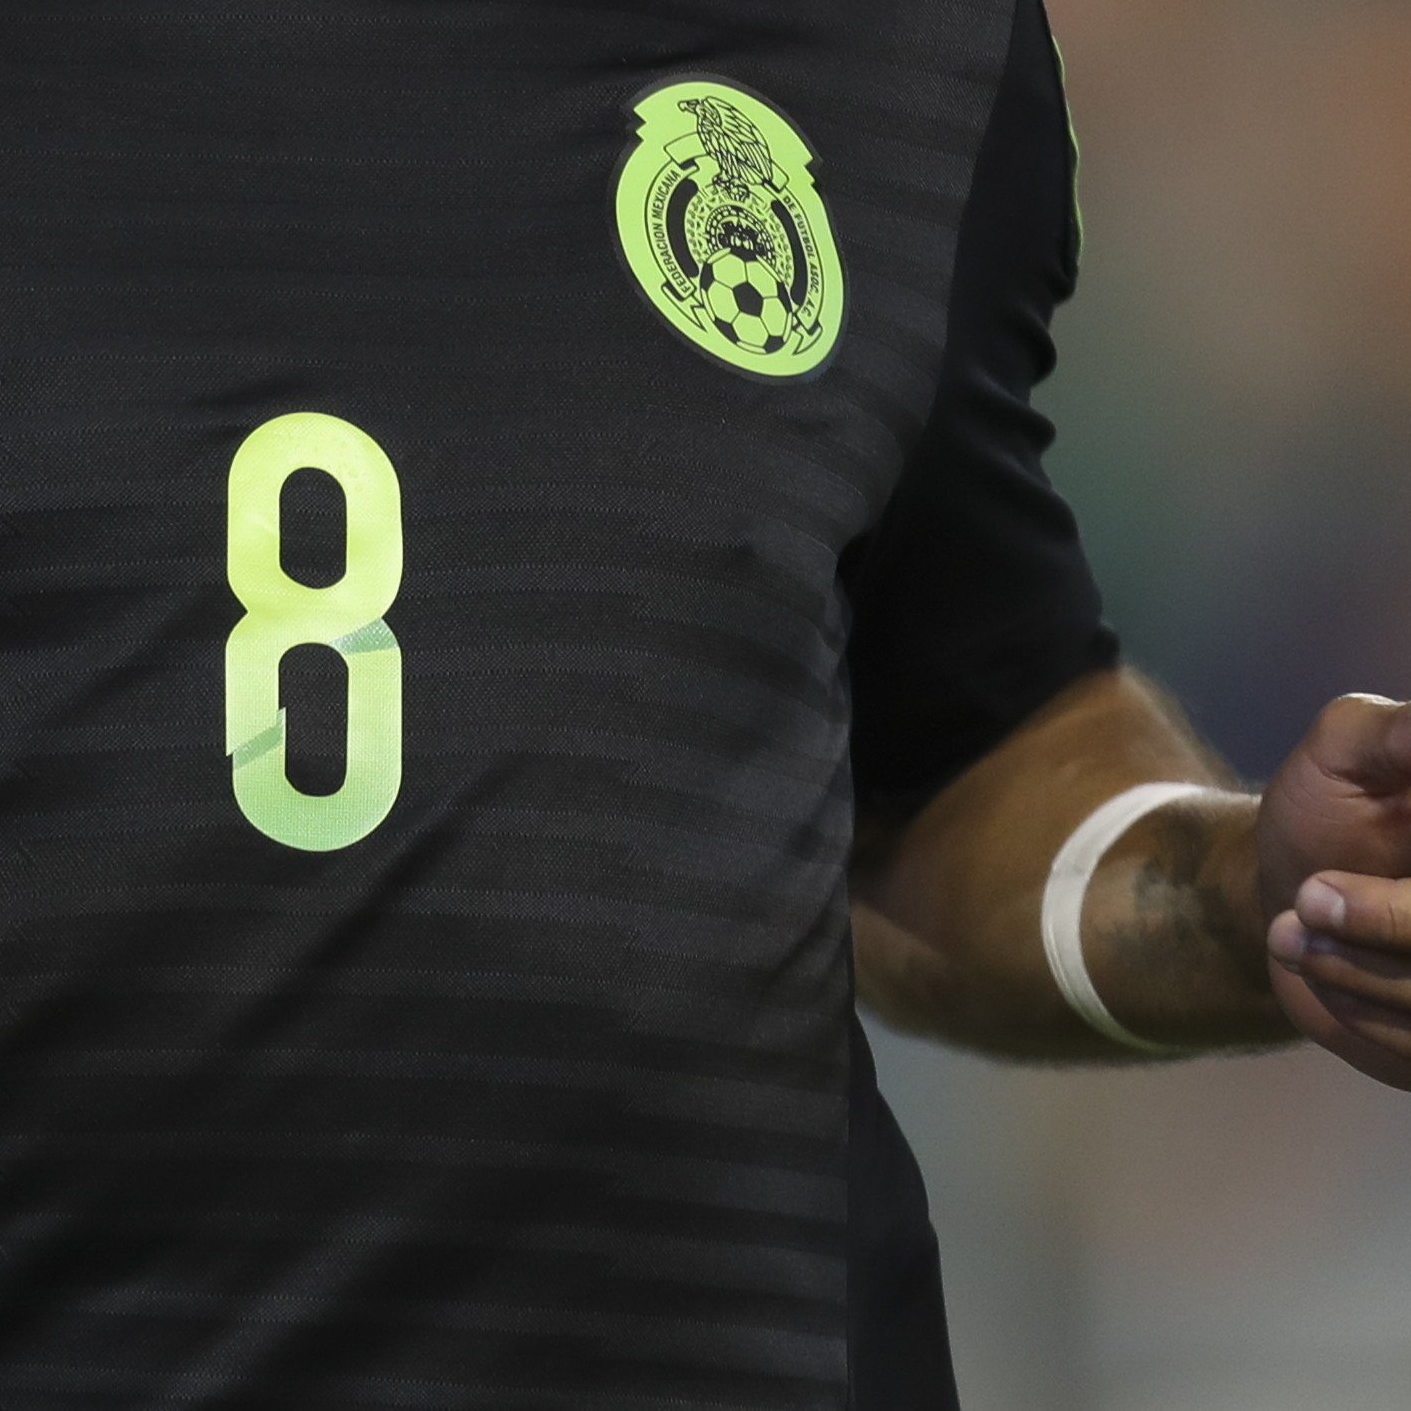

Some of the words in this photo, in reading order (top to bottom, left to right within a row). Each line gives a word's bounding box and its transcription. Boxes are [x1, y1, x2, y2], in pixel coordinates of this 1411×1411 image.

[651, 169, 680, 218] MEXICANA
[783, 195, 796, 211] DE
[794, 214, 815, 257] FUTBOL
[653, 223, 691, 293] FEDERACION
[225, 411, 403, 852] 8
